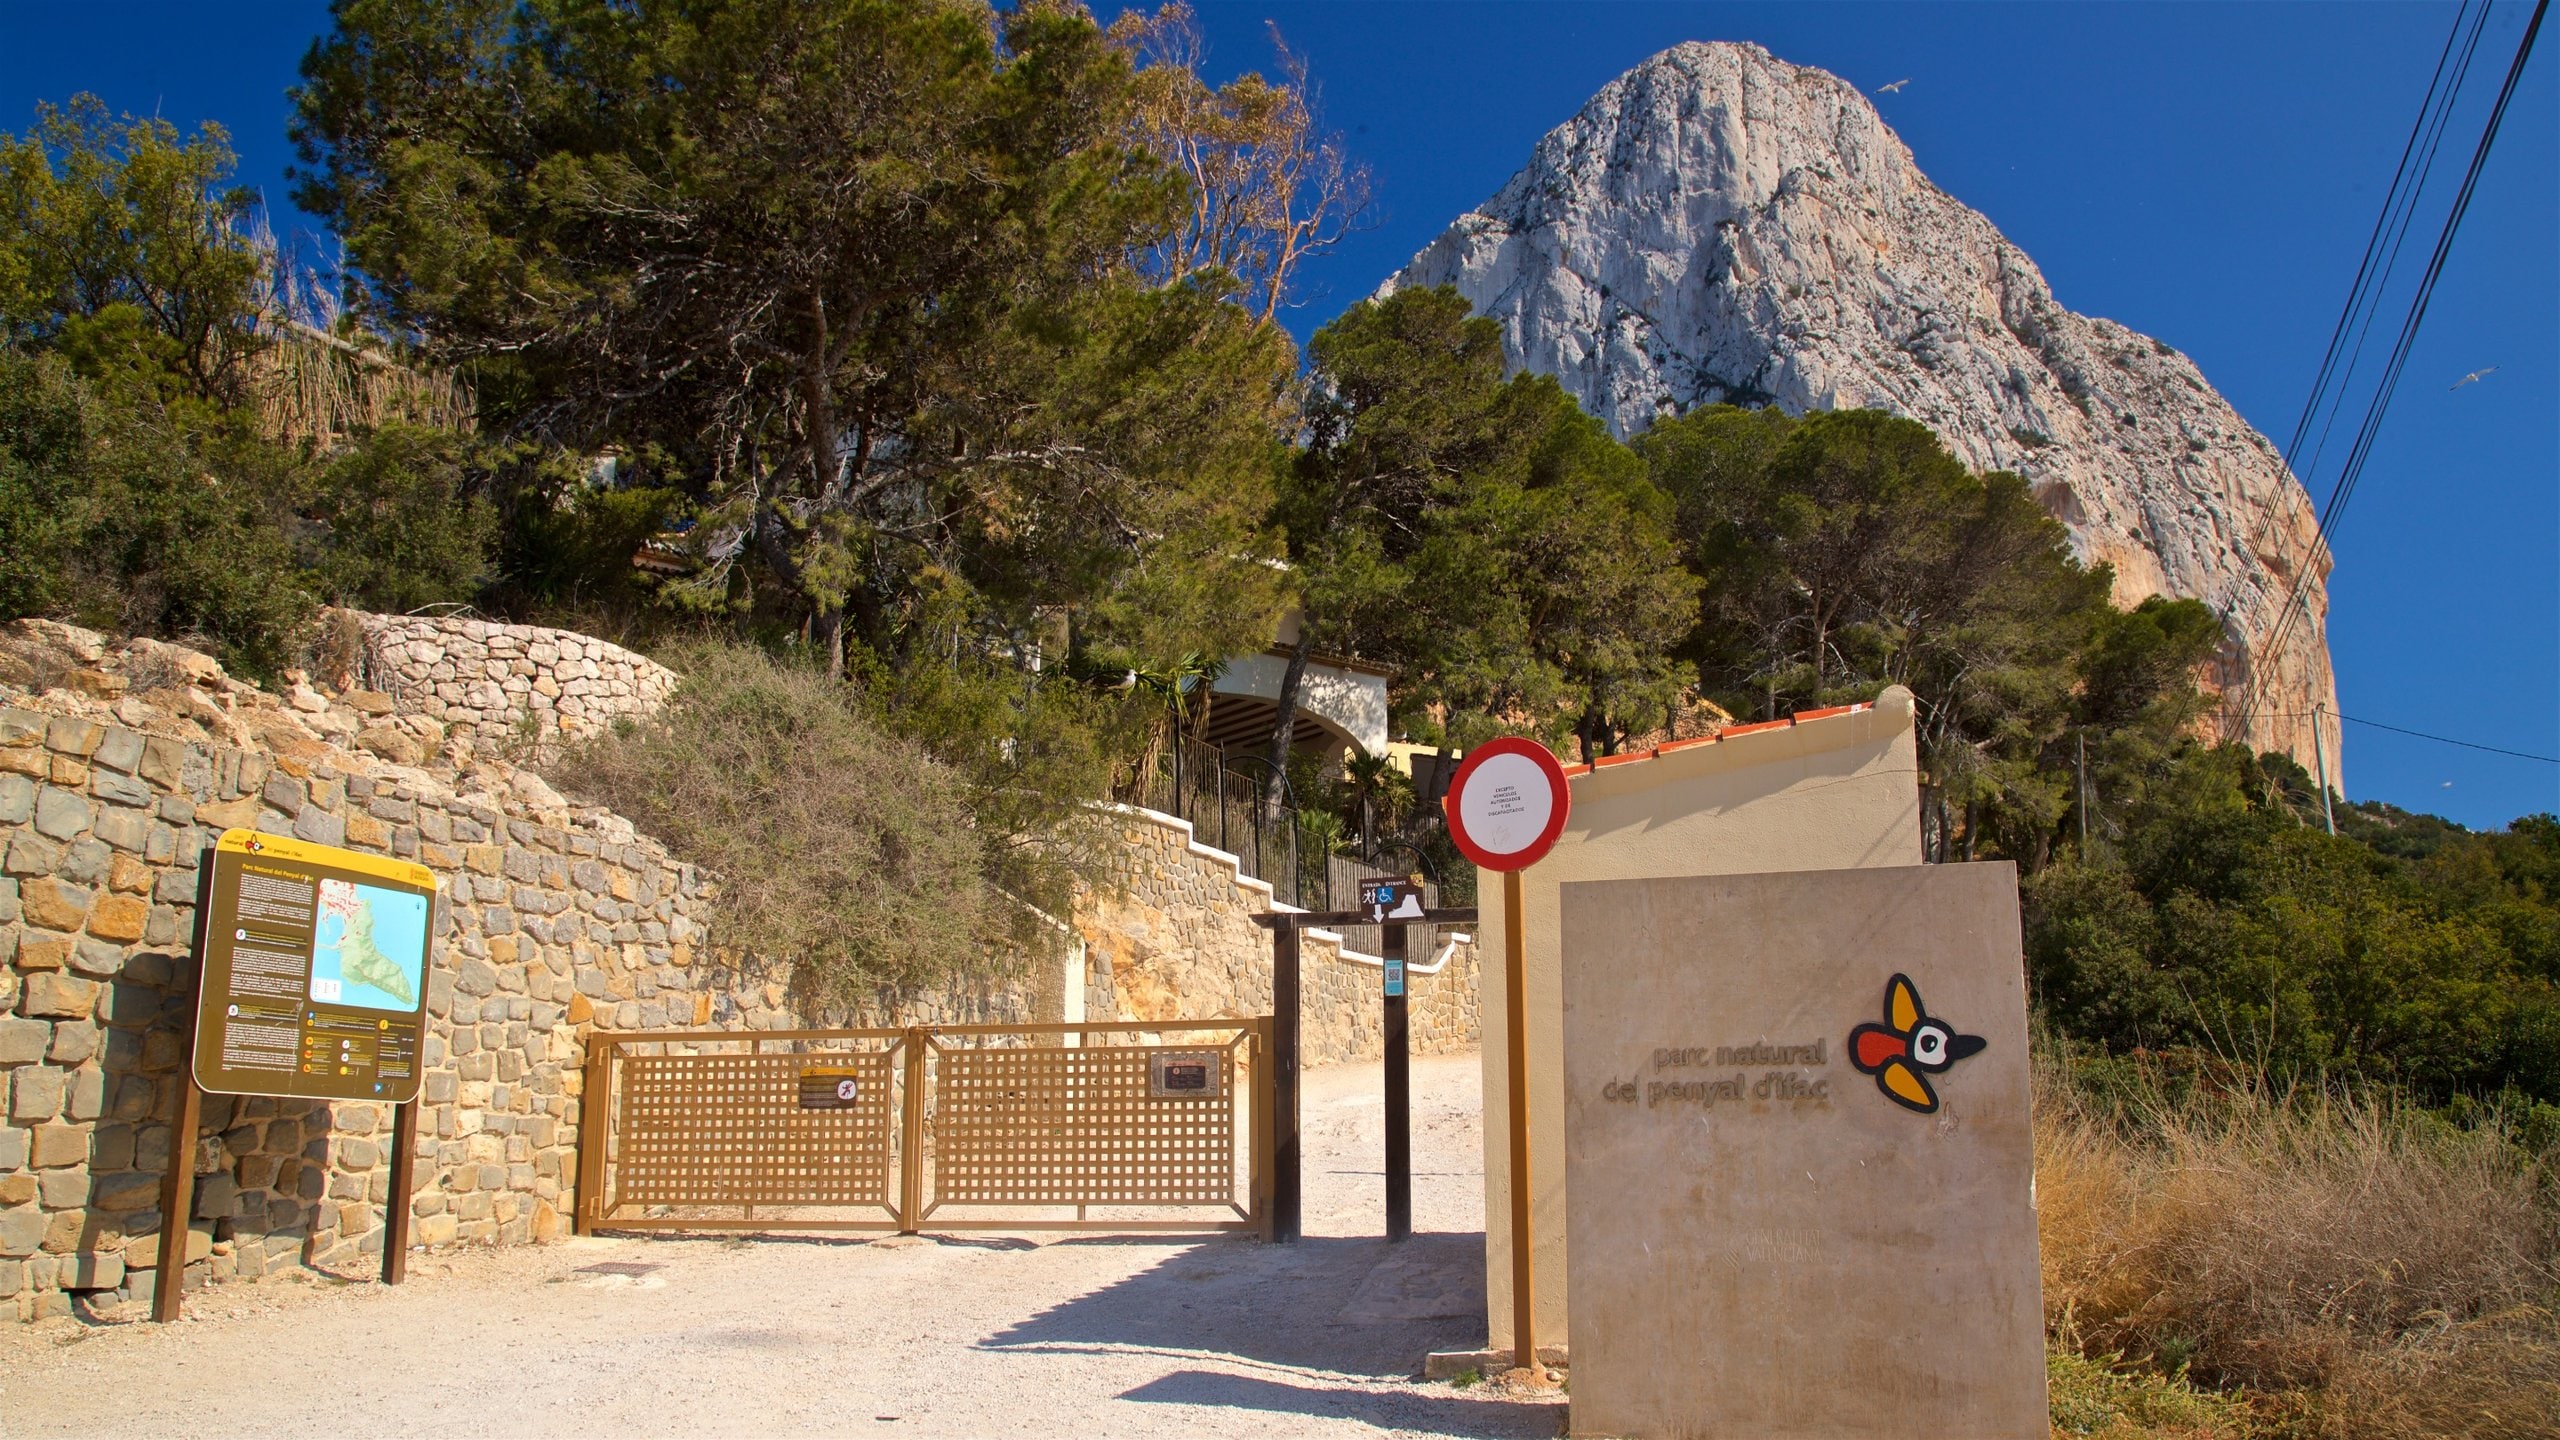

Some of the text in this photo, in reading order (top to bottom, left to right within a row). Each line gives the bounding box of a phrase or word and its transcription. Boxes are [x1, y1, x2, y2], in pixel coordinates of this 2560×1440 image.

[242, 863, 253, 871] Parc
[254, 865, 274, 874] Natural
[1654, 1038, 1828, 1074] parc natural
[1602, 1074, 1640, 1104] del
[1647, 1073, 1745, 1109] penyal
[1746, 1228, 1821, 1246] GENERALITAT
[1746, 1245, 1823, 1263] VALENCIANA
